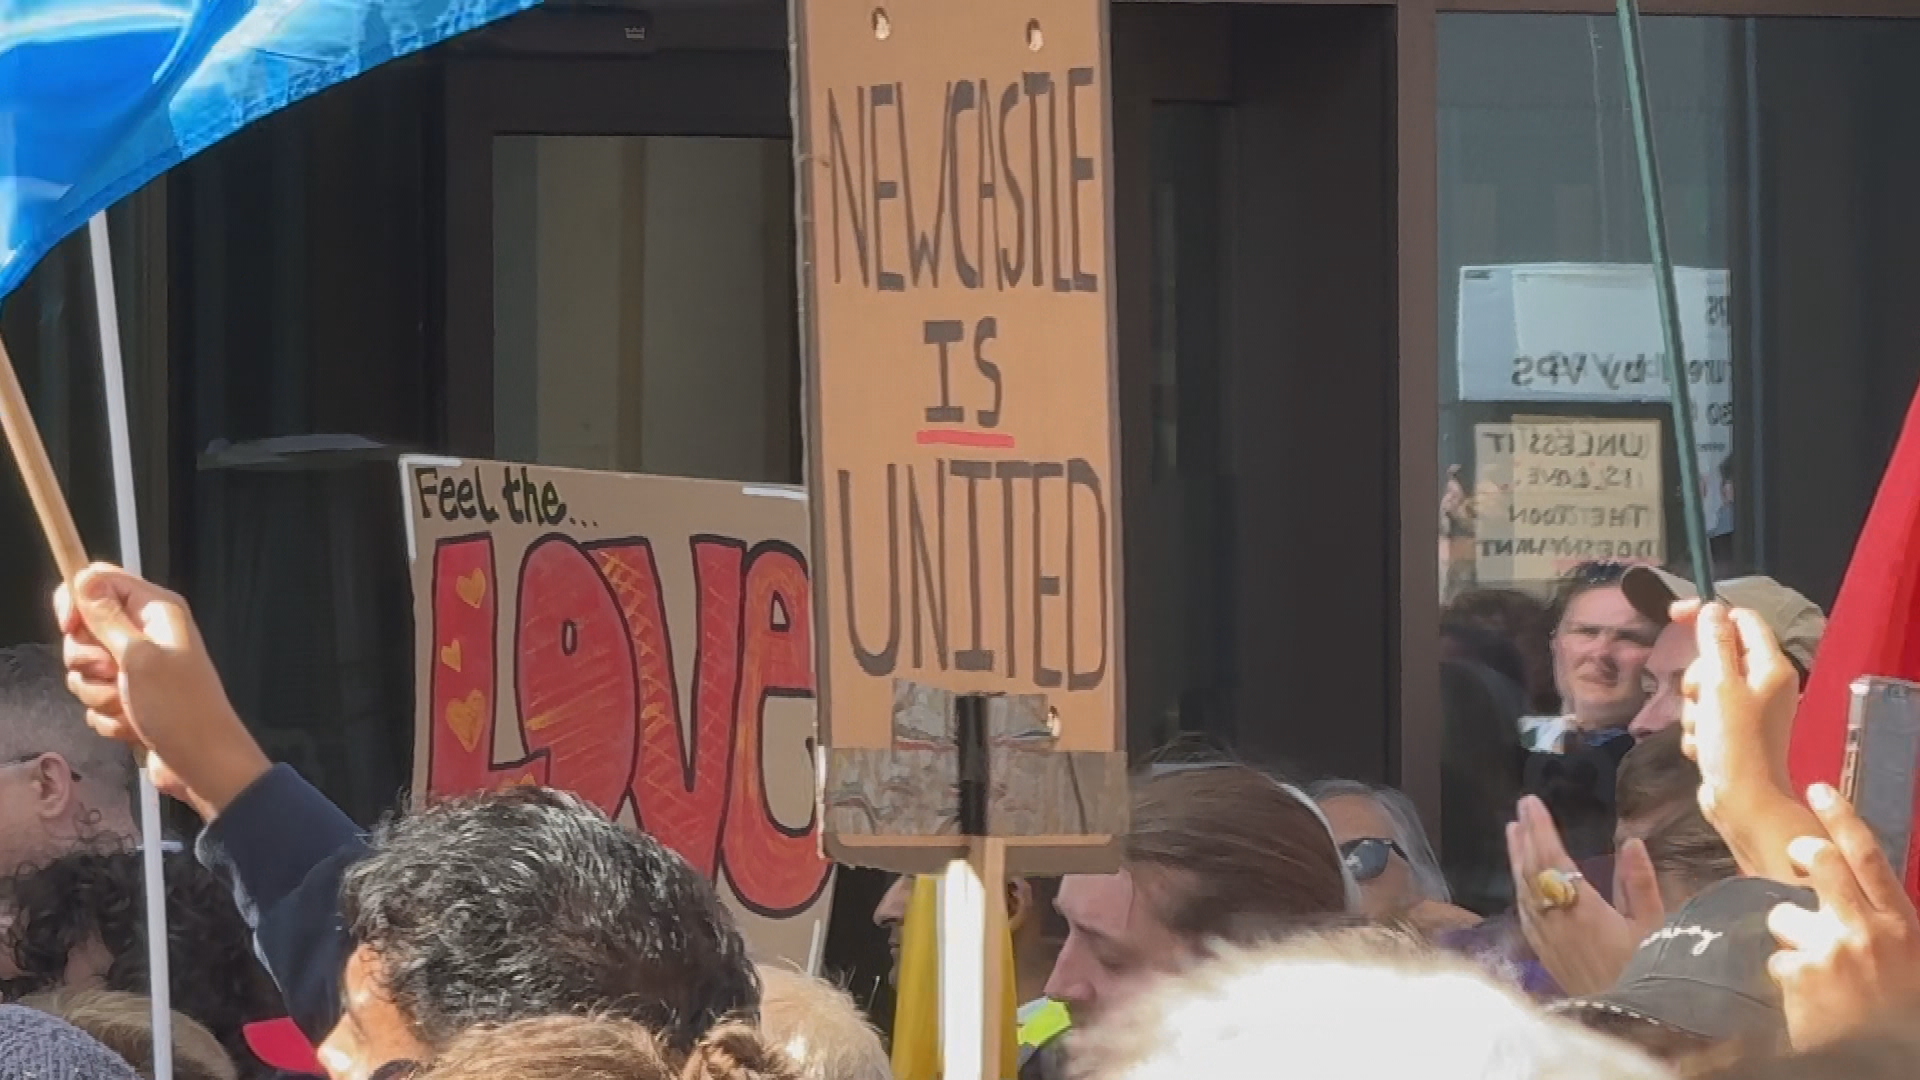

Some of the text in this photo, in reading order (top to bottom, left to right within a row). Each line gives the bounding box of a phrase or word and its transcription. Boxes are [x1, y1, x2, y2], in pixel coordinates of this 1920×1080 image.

[828, 67, 1098, 292] NEWCASTLE
[923, 316, 1001, 428] IS
[415, 466, 500, 523] Feel
[838, 458, 1107, 691] UNITED
